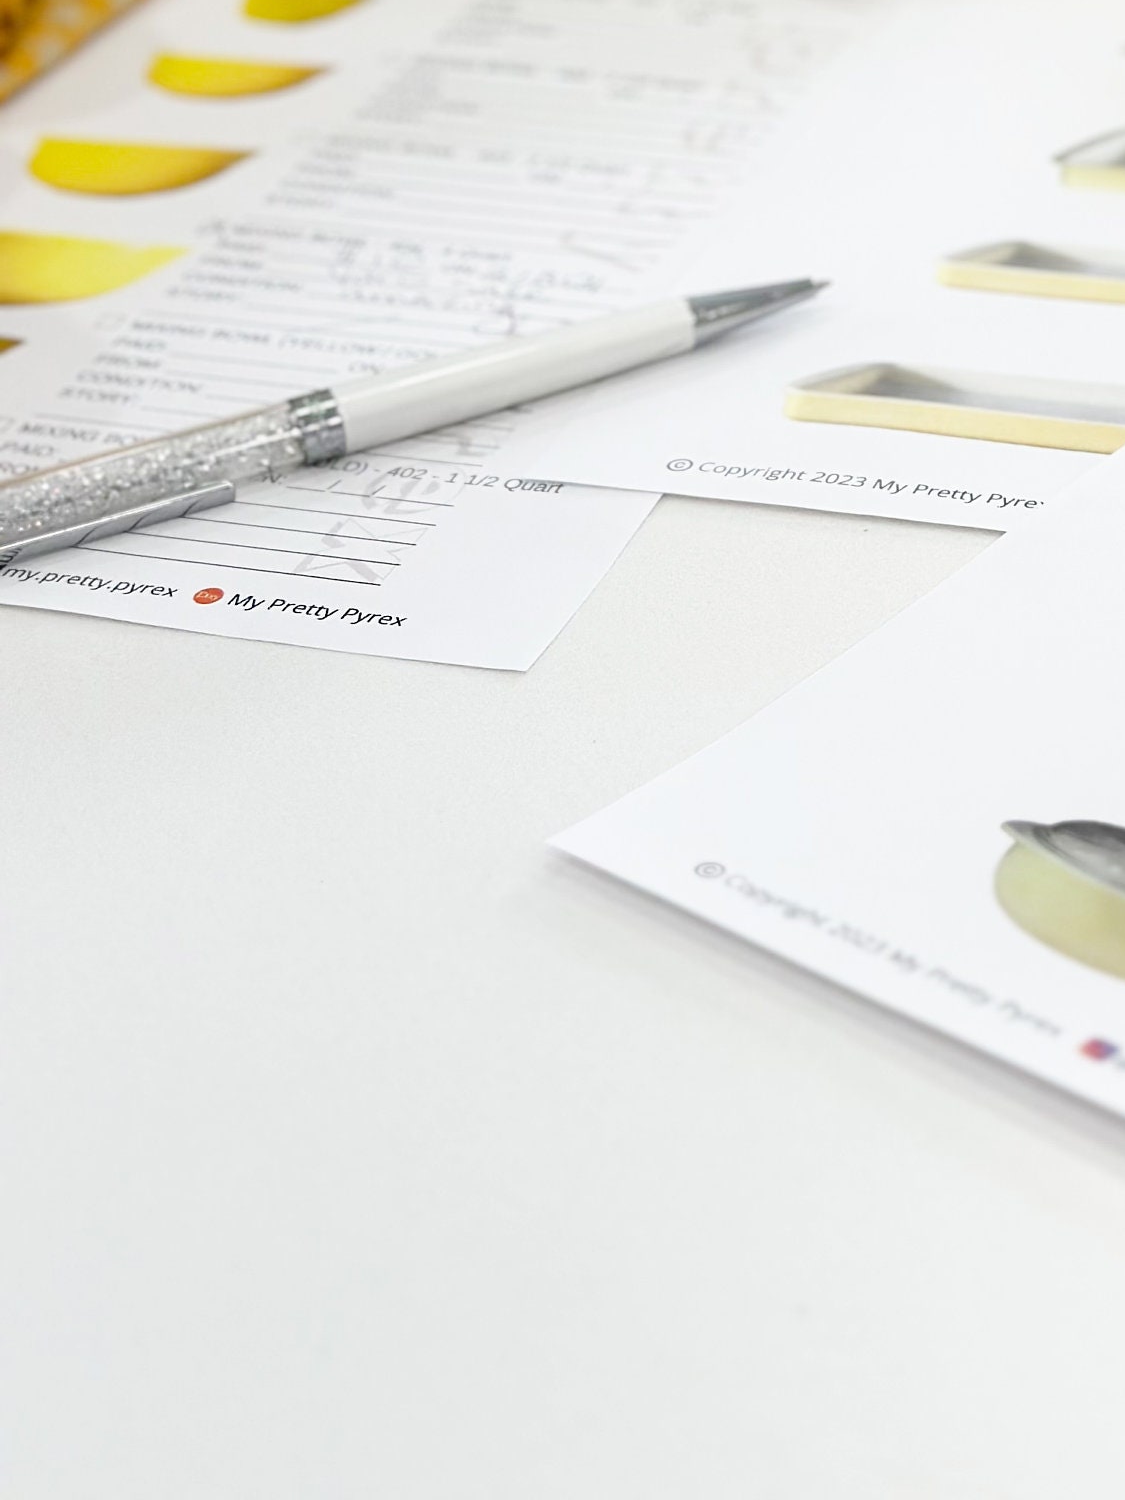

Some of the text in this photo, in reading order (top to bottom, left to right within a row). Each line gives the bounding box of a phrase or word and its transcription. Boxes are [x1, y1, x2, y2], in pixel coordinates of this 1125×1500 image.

[388, 465, 428, 482] 402
[464, 473, 499, 488] 1/2
[504, 478, 564, 495] Quart
[698, 461, 806, 482] Copyright
[810, 470, 867, 488] 2023
[872, 478, 905, 495] My
[912, 483, 982, 506] Pretty
[987, 492, 1046, 510] Pyre
[2, 564, 179, 599] my.pretty.pyrex
[228, 593, 262, 612] My
[268, 598, 337, 620] Pretty
[341, 607, 408, 628] Pyrex
